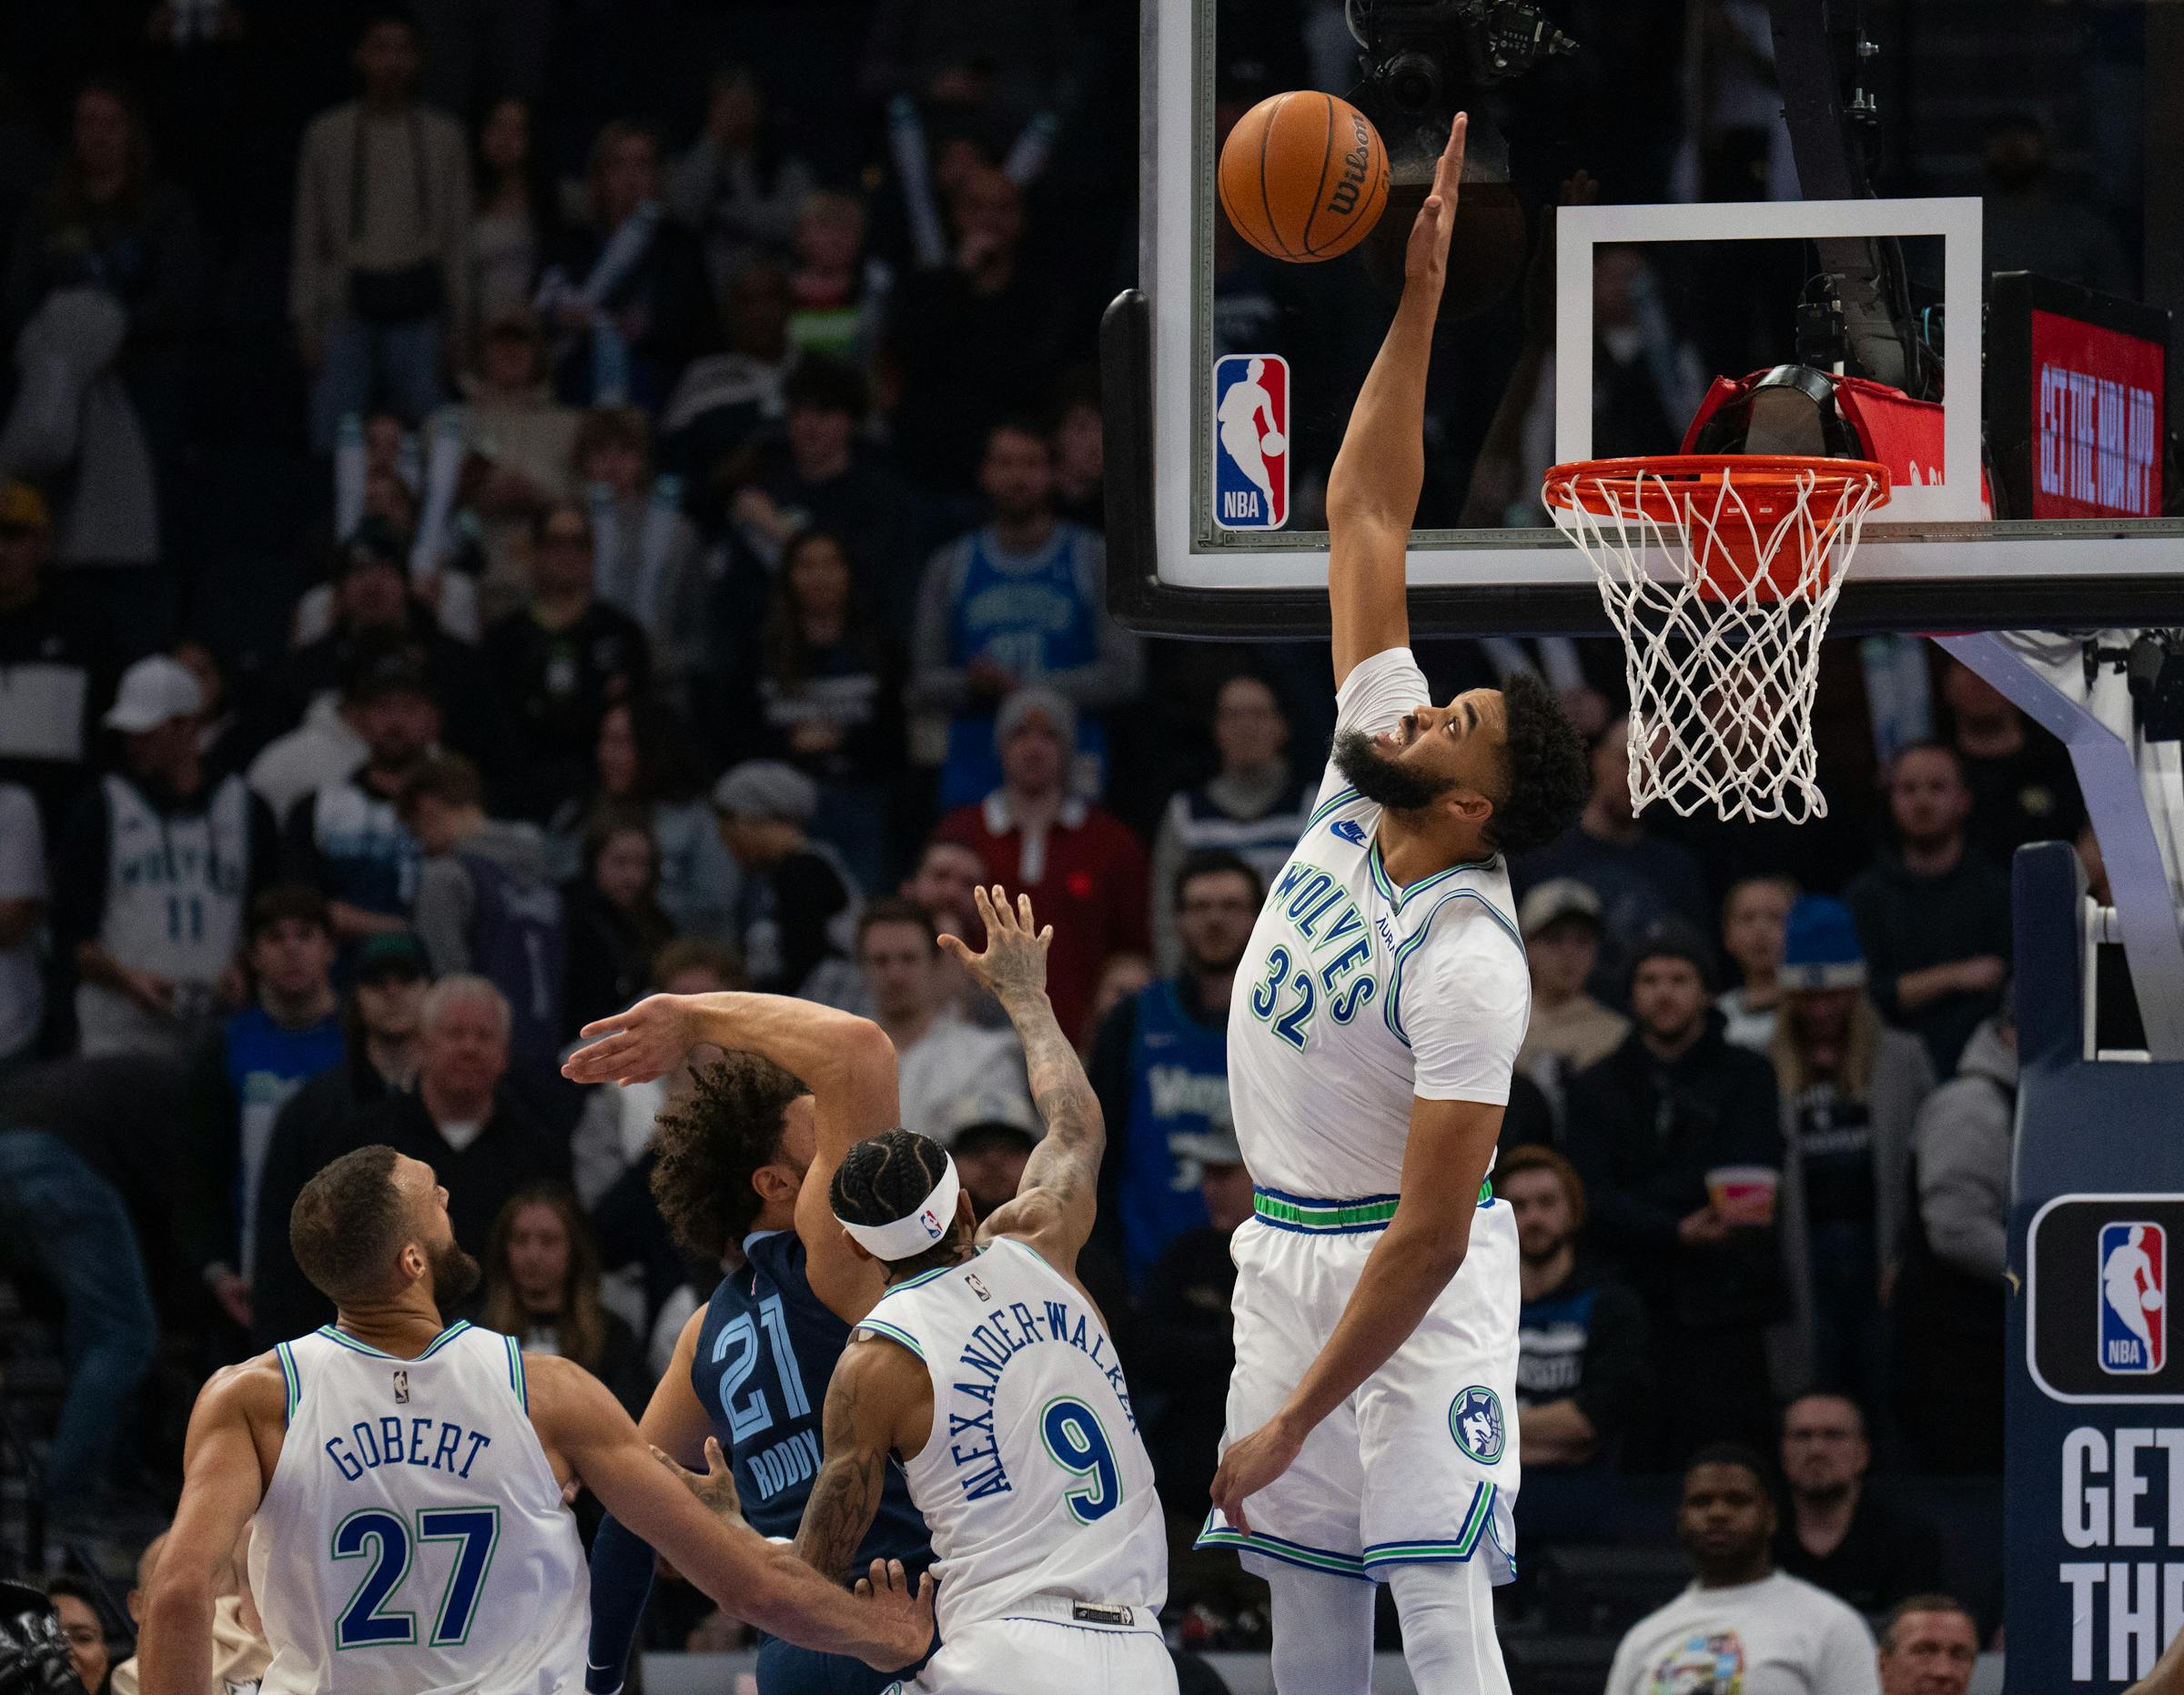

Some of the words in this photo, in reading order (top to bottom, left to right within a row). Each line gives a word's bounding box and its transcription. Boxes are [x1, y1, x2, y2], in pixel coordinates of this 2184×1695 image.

[1328, 114, 1370, 216] Wilson
[2040, 362, 2068, 497] GET
[2069, 370, 2096, 504] THE
[2098, 378, 2125, 511] NBA
[1224, 491, 1259, 518] NBA
[1251, 943, 1316, 1054] 32
[1267, 862, 1378, 1025] WOLVES
[712, 1293, 811, 1445] 21
[2108, 1339, 2140, 1364] NBA
[326, 1417, 490, 1481] GOBERT
[746, 1428, 823, 1501] RODDY
[1040, 1396, 1123, 1526] 9
[2062, 1427, 2184, 1548] GET
[331, 1505, 500, 1650] 27
